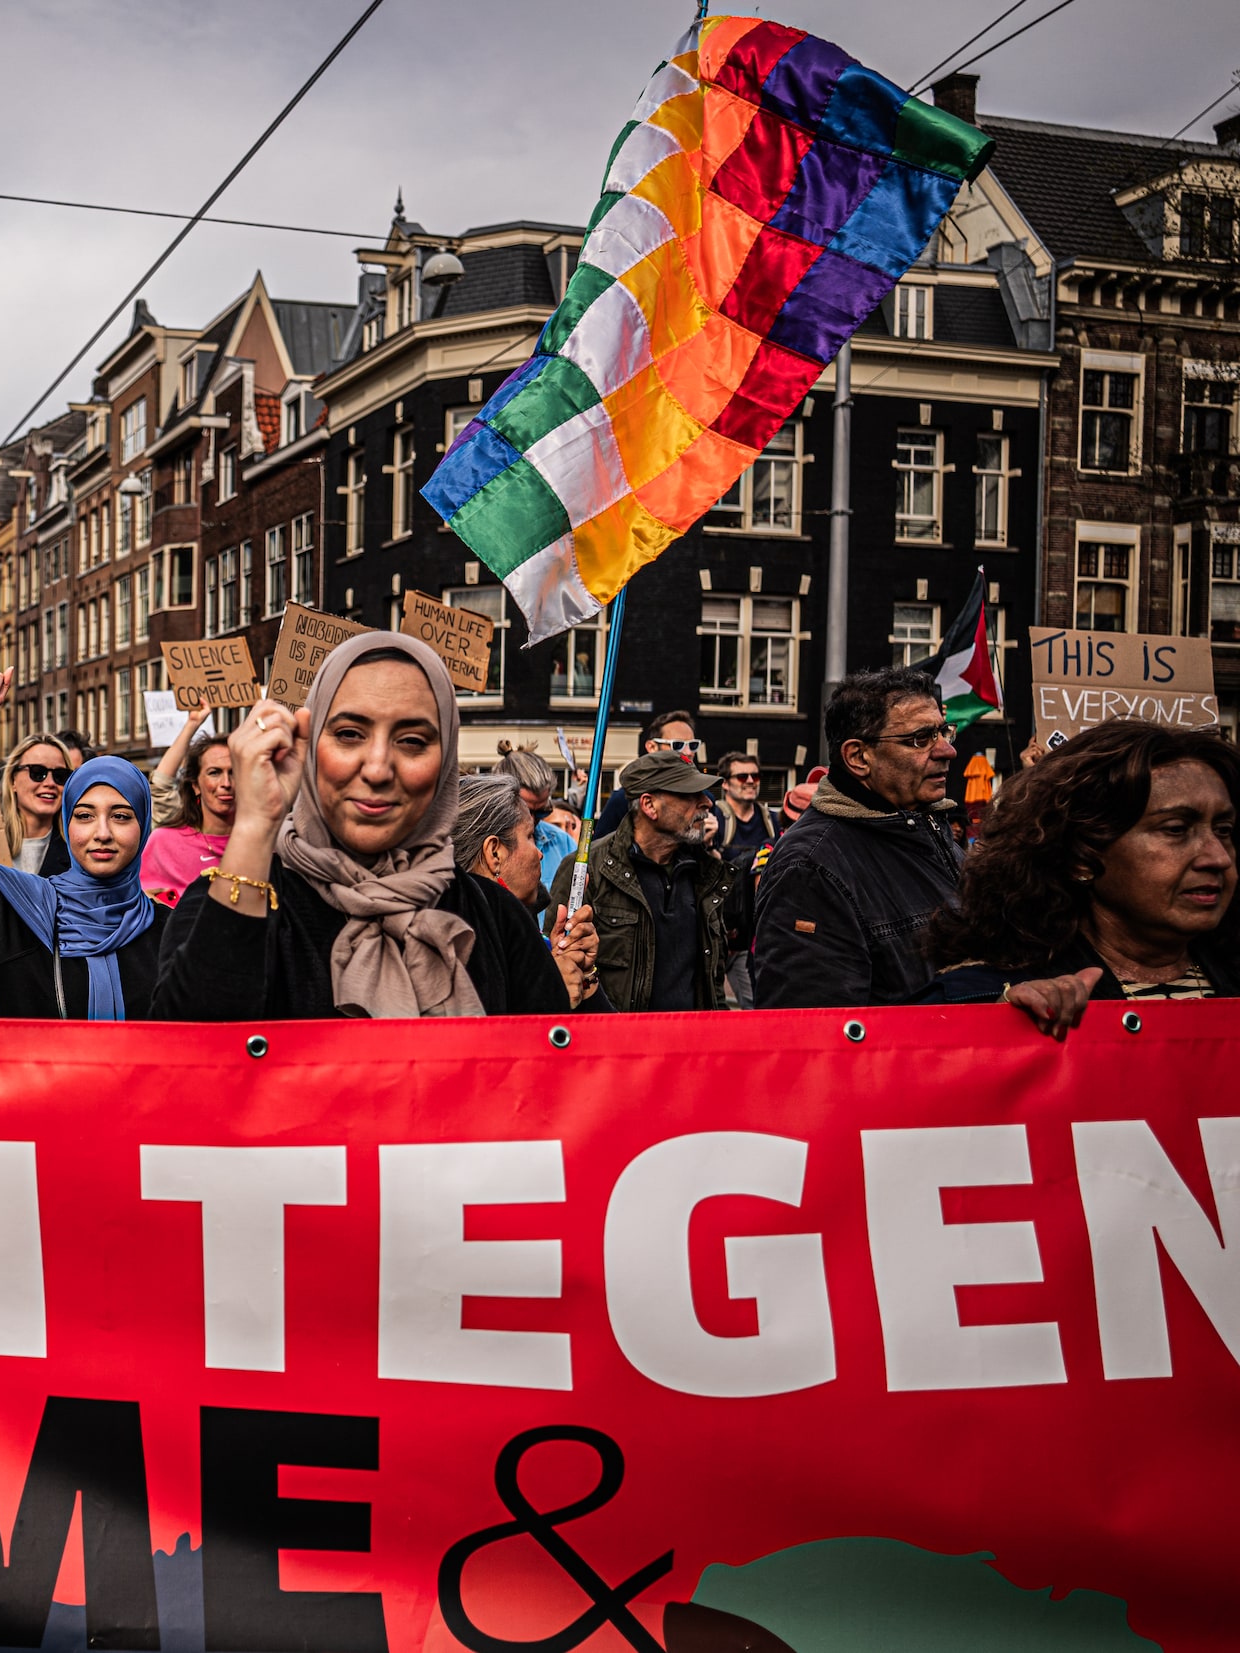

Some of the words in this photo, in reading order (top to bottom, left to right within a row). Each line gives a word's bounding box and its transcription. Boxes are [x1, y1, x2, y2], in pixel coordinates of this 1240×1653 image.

[295, 613, 357, 645] NOBODY
[414, 599, 456, 628] HUMAN
[458, 615, 486, 638] LIFE
[289, 639, 307, 662] IS
[420, 622, 471, 656] OVER
[169, 644, 243, 670] SILENCE
[440, 655, 482, 682] ATERIAL
[177, 682, 256, 707] COMPLICITY
[140, 1116, 1240, 1399] TEGEN
[437, 1424, 675, 1653] &
